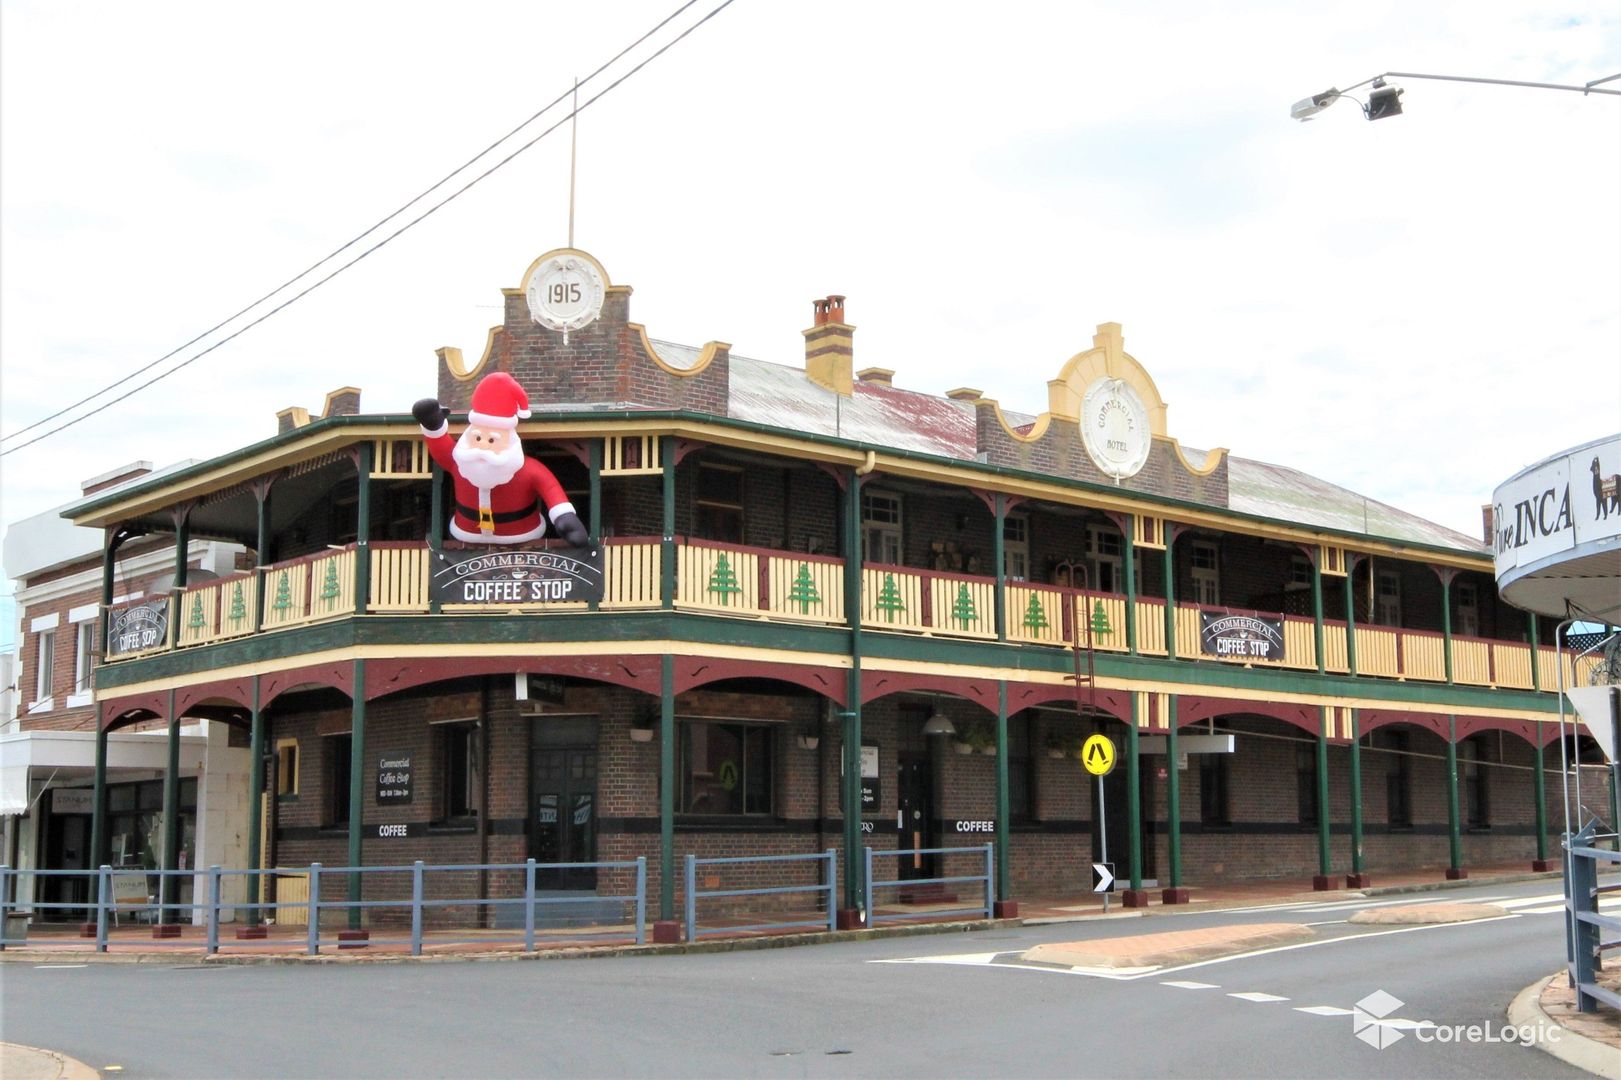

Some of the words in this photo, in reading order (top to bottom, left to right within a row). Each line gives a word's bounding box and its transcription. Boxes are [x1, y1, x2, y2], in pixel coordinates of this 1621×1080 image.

[548, 282, 582, 304] 1915
[1098, 399, 1134, 432] COMMERCIAL
[1106, 439, 1129, 453] HOTEL
[1513, 481, 1573, 549] INCA
[455, 553, 581, 576] COMMERCIAL
[463, 580, 522, 601] COFFEE
[531, 580, 573, 600] STOP
[1212, 619, 1274, 638] COMMERCIAL
[1216, 638, 1247, 655] COFFEE
[1250, 640, 1270, 656] STOP
[379, 824, 408, 837] COFFEE
[956, 820, 994, 832] COFFEE
